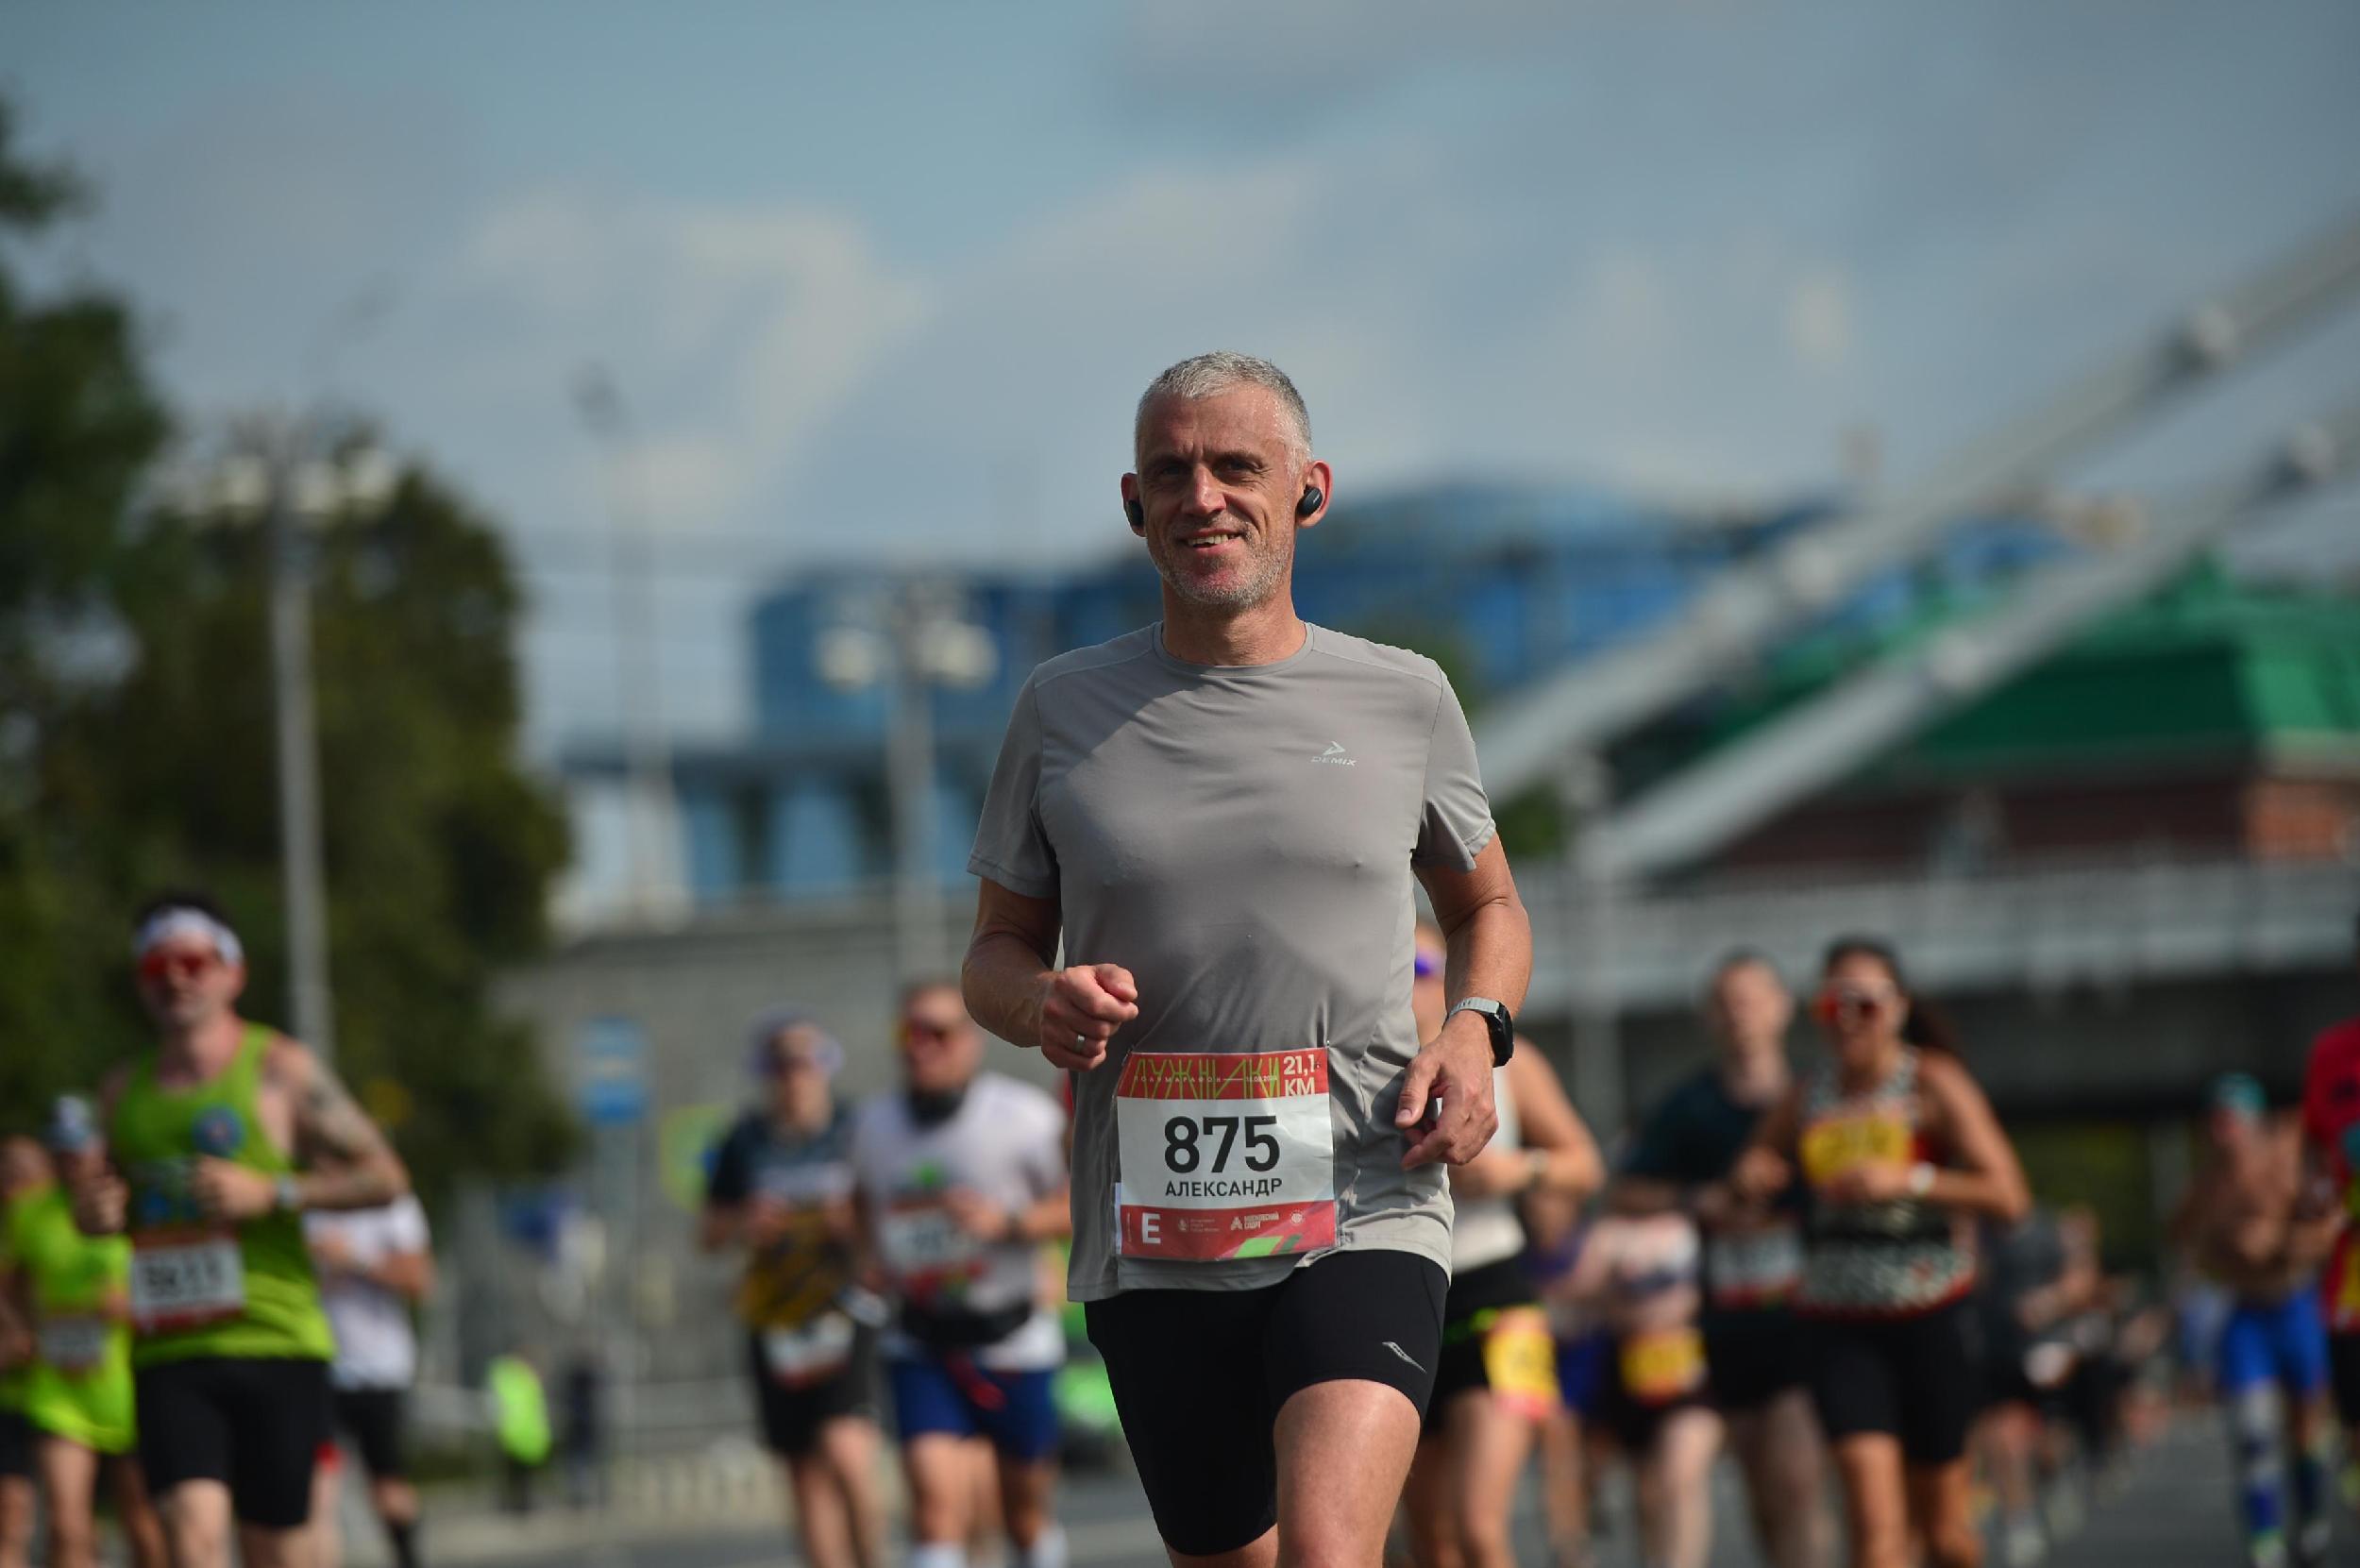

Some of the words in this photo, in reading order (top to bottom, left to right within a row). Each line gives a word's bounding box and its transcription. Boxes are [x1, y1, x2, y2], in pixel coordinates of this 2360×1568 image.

[1310, 755, 1357, 767] DEMIX
[1284, 1054, 1317, 1076] 21,1
[1128, 1056, 1281, 1100] ЛУЖНИКИ
[1164, 1115, 1280, 1173] 875
[1165, 1178, 1283, 1197] АЛЕКСАНДР
